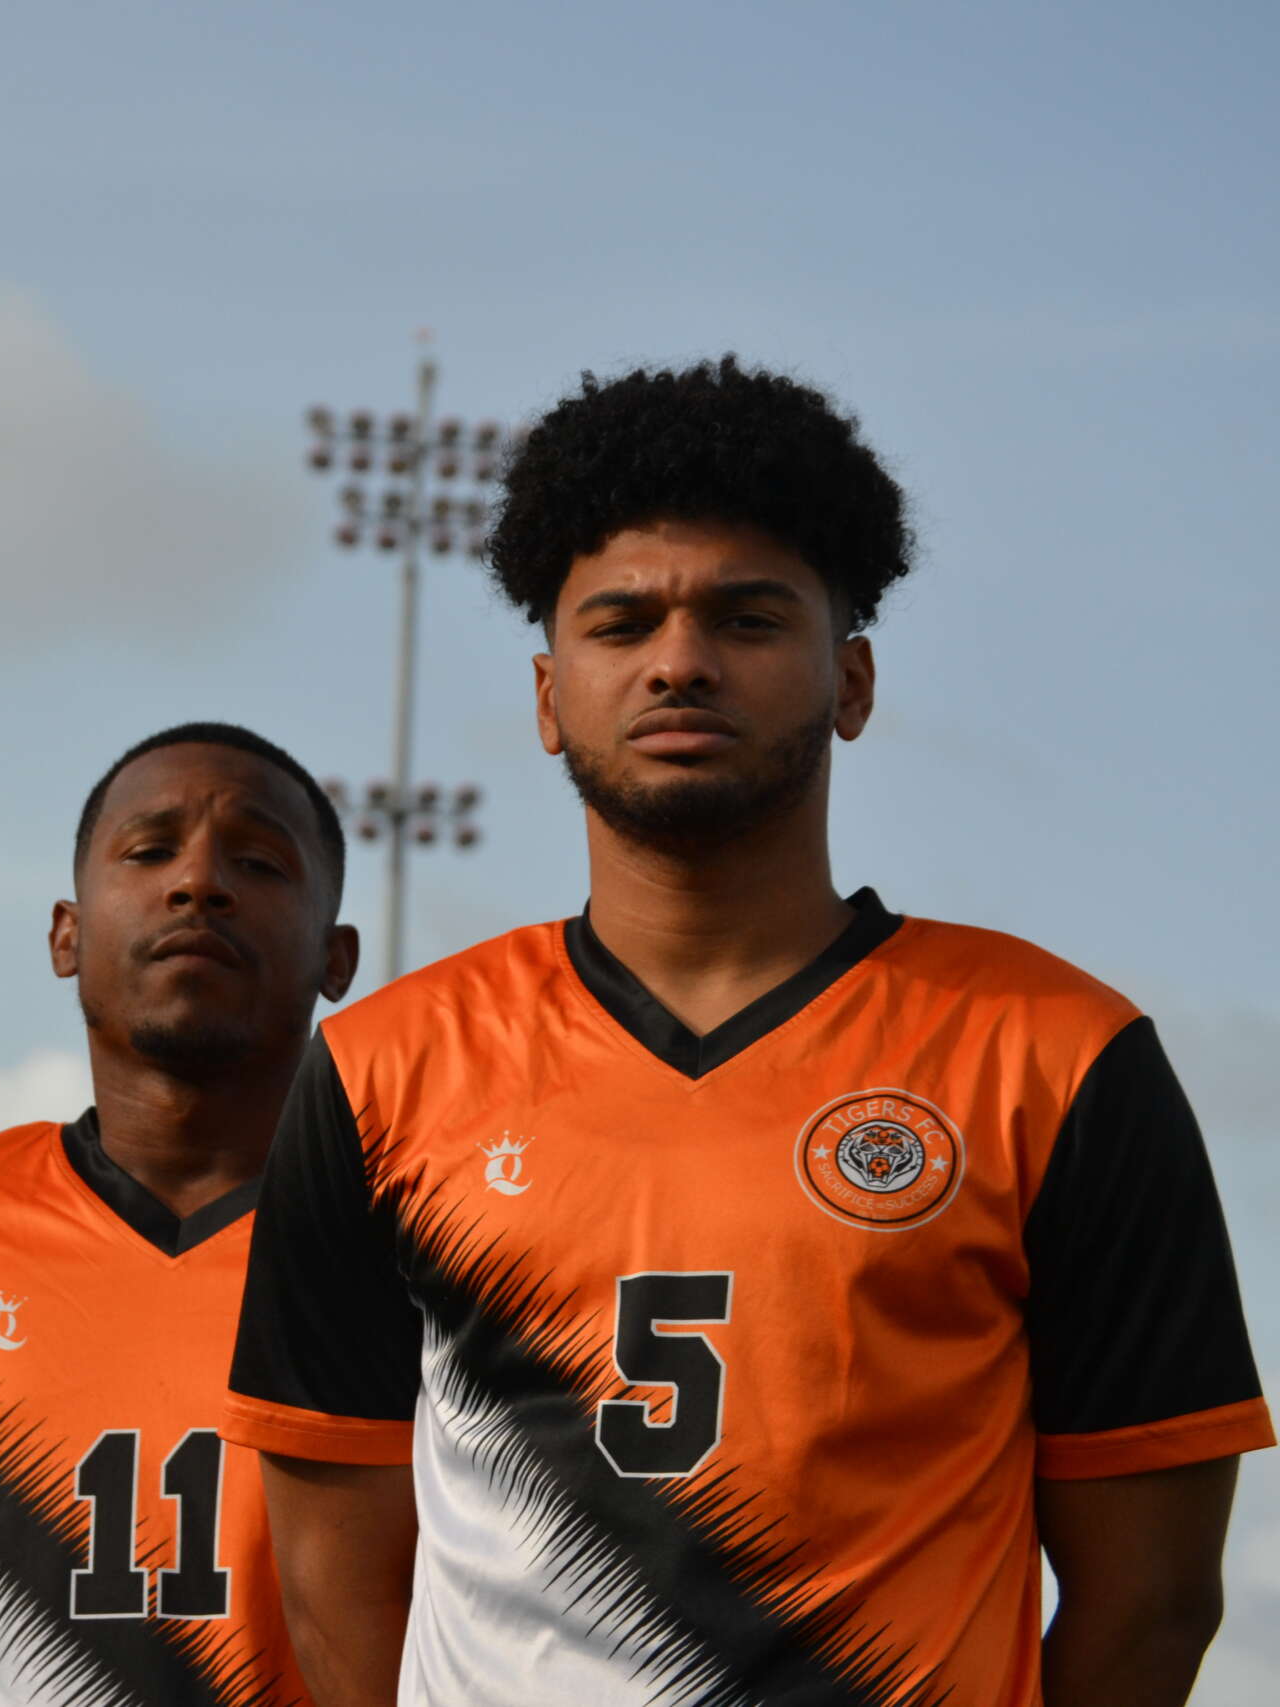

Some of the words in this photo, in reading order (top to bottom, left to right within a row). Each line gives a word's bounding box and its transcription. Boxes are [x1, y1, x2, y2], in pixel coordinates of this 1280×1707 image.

[822, 1099, 915, 1134] TIGERS
[915, 1117, 945, 1145] FC
[594, 1270, 735, 1478] 5
[69, 1428, 232, 1620] 11
